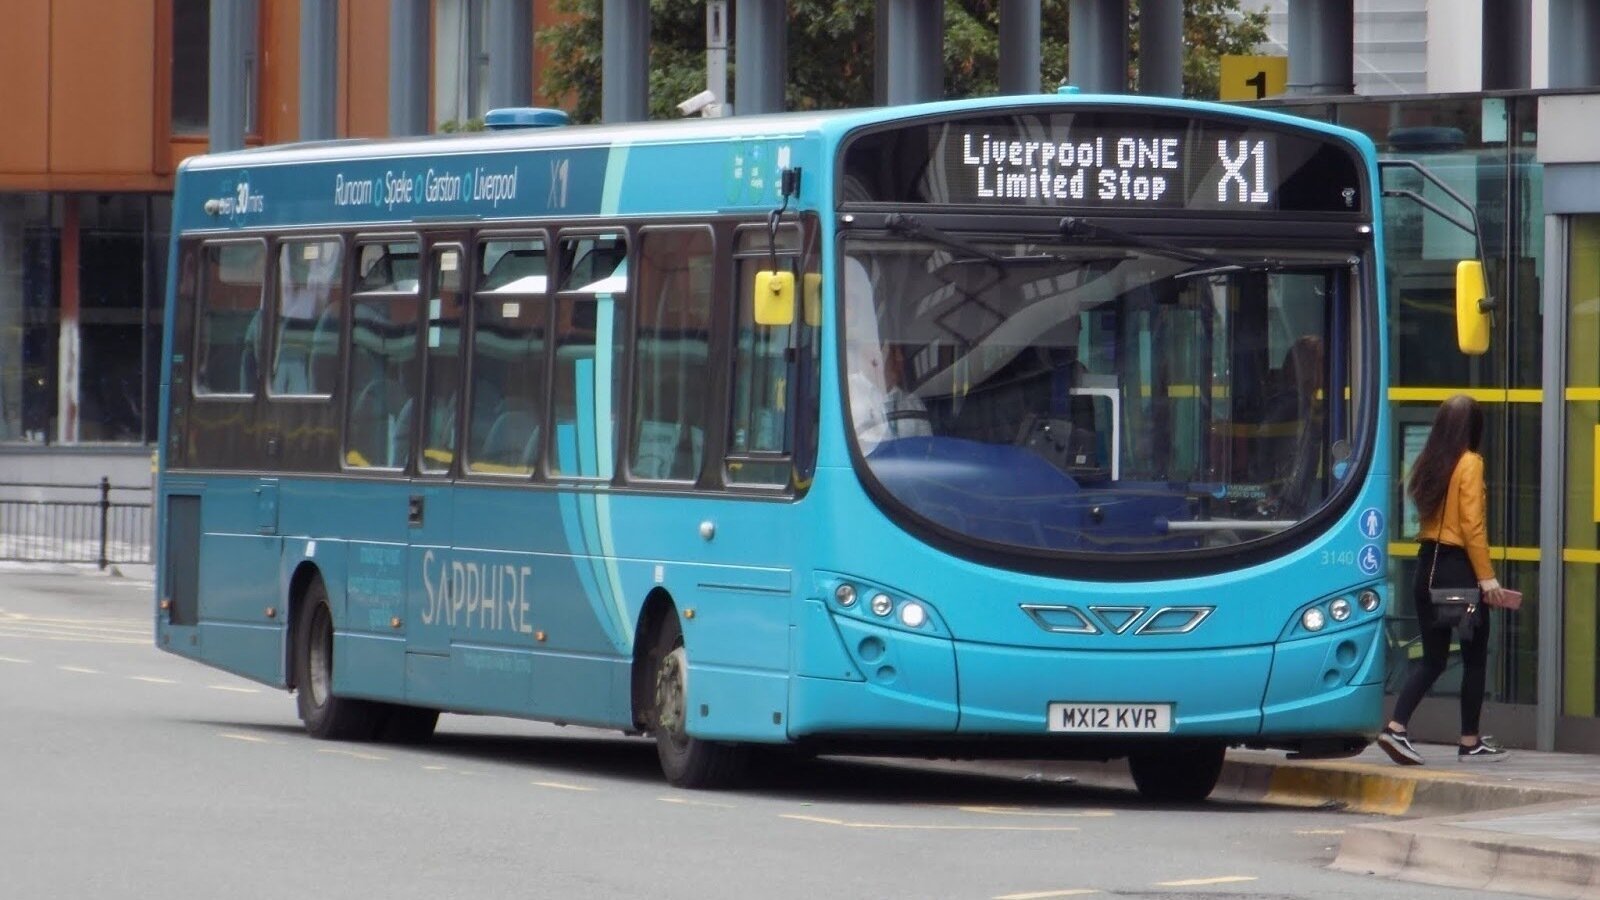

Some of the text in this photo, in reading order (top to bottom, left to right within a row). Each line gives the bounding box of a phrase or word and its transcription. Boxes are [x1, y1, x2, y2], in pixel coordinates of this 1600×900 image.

[1245, 71, 1266, 99] 1
[964, 134, 1178, 168] Liverpool ONE
[335, 165, 518, 211] Runcorn Speke Garston Liverpool
[547, 159, 569, 209] X1
[977, 166, 1166, 200] Limited Stop
[1217, 139, 1269, 203] X1
[236, 183, 249, 214] 30
[1321, 550, 1354, 565] 3140
[421, 549, 533, 633] SAPPHIRE
[1063, 708, 1157, 729] MX12 KVR
